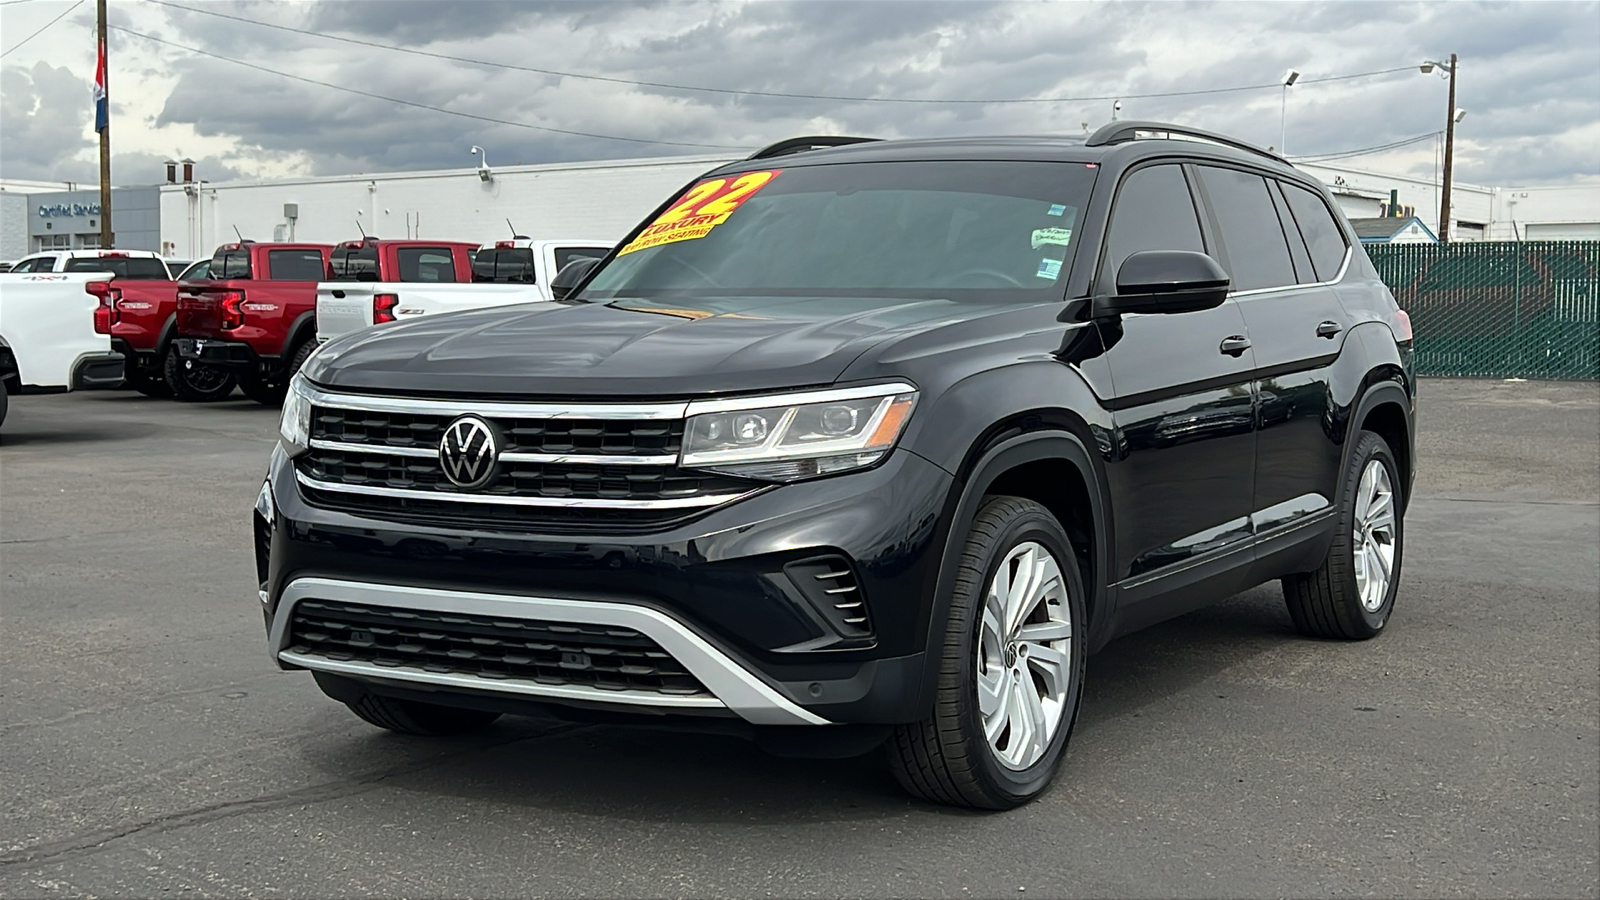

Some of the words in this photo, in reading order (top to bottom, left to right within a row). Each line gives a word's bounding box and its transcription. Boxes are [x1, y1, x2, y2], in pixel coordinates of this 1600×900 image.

[652, 171, 773, 226] 22
[39, 204, 73, 218] Certified
[641, 213, 726, 238] LUXURY
[664, 227, 711, 240] SEATING
